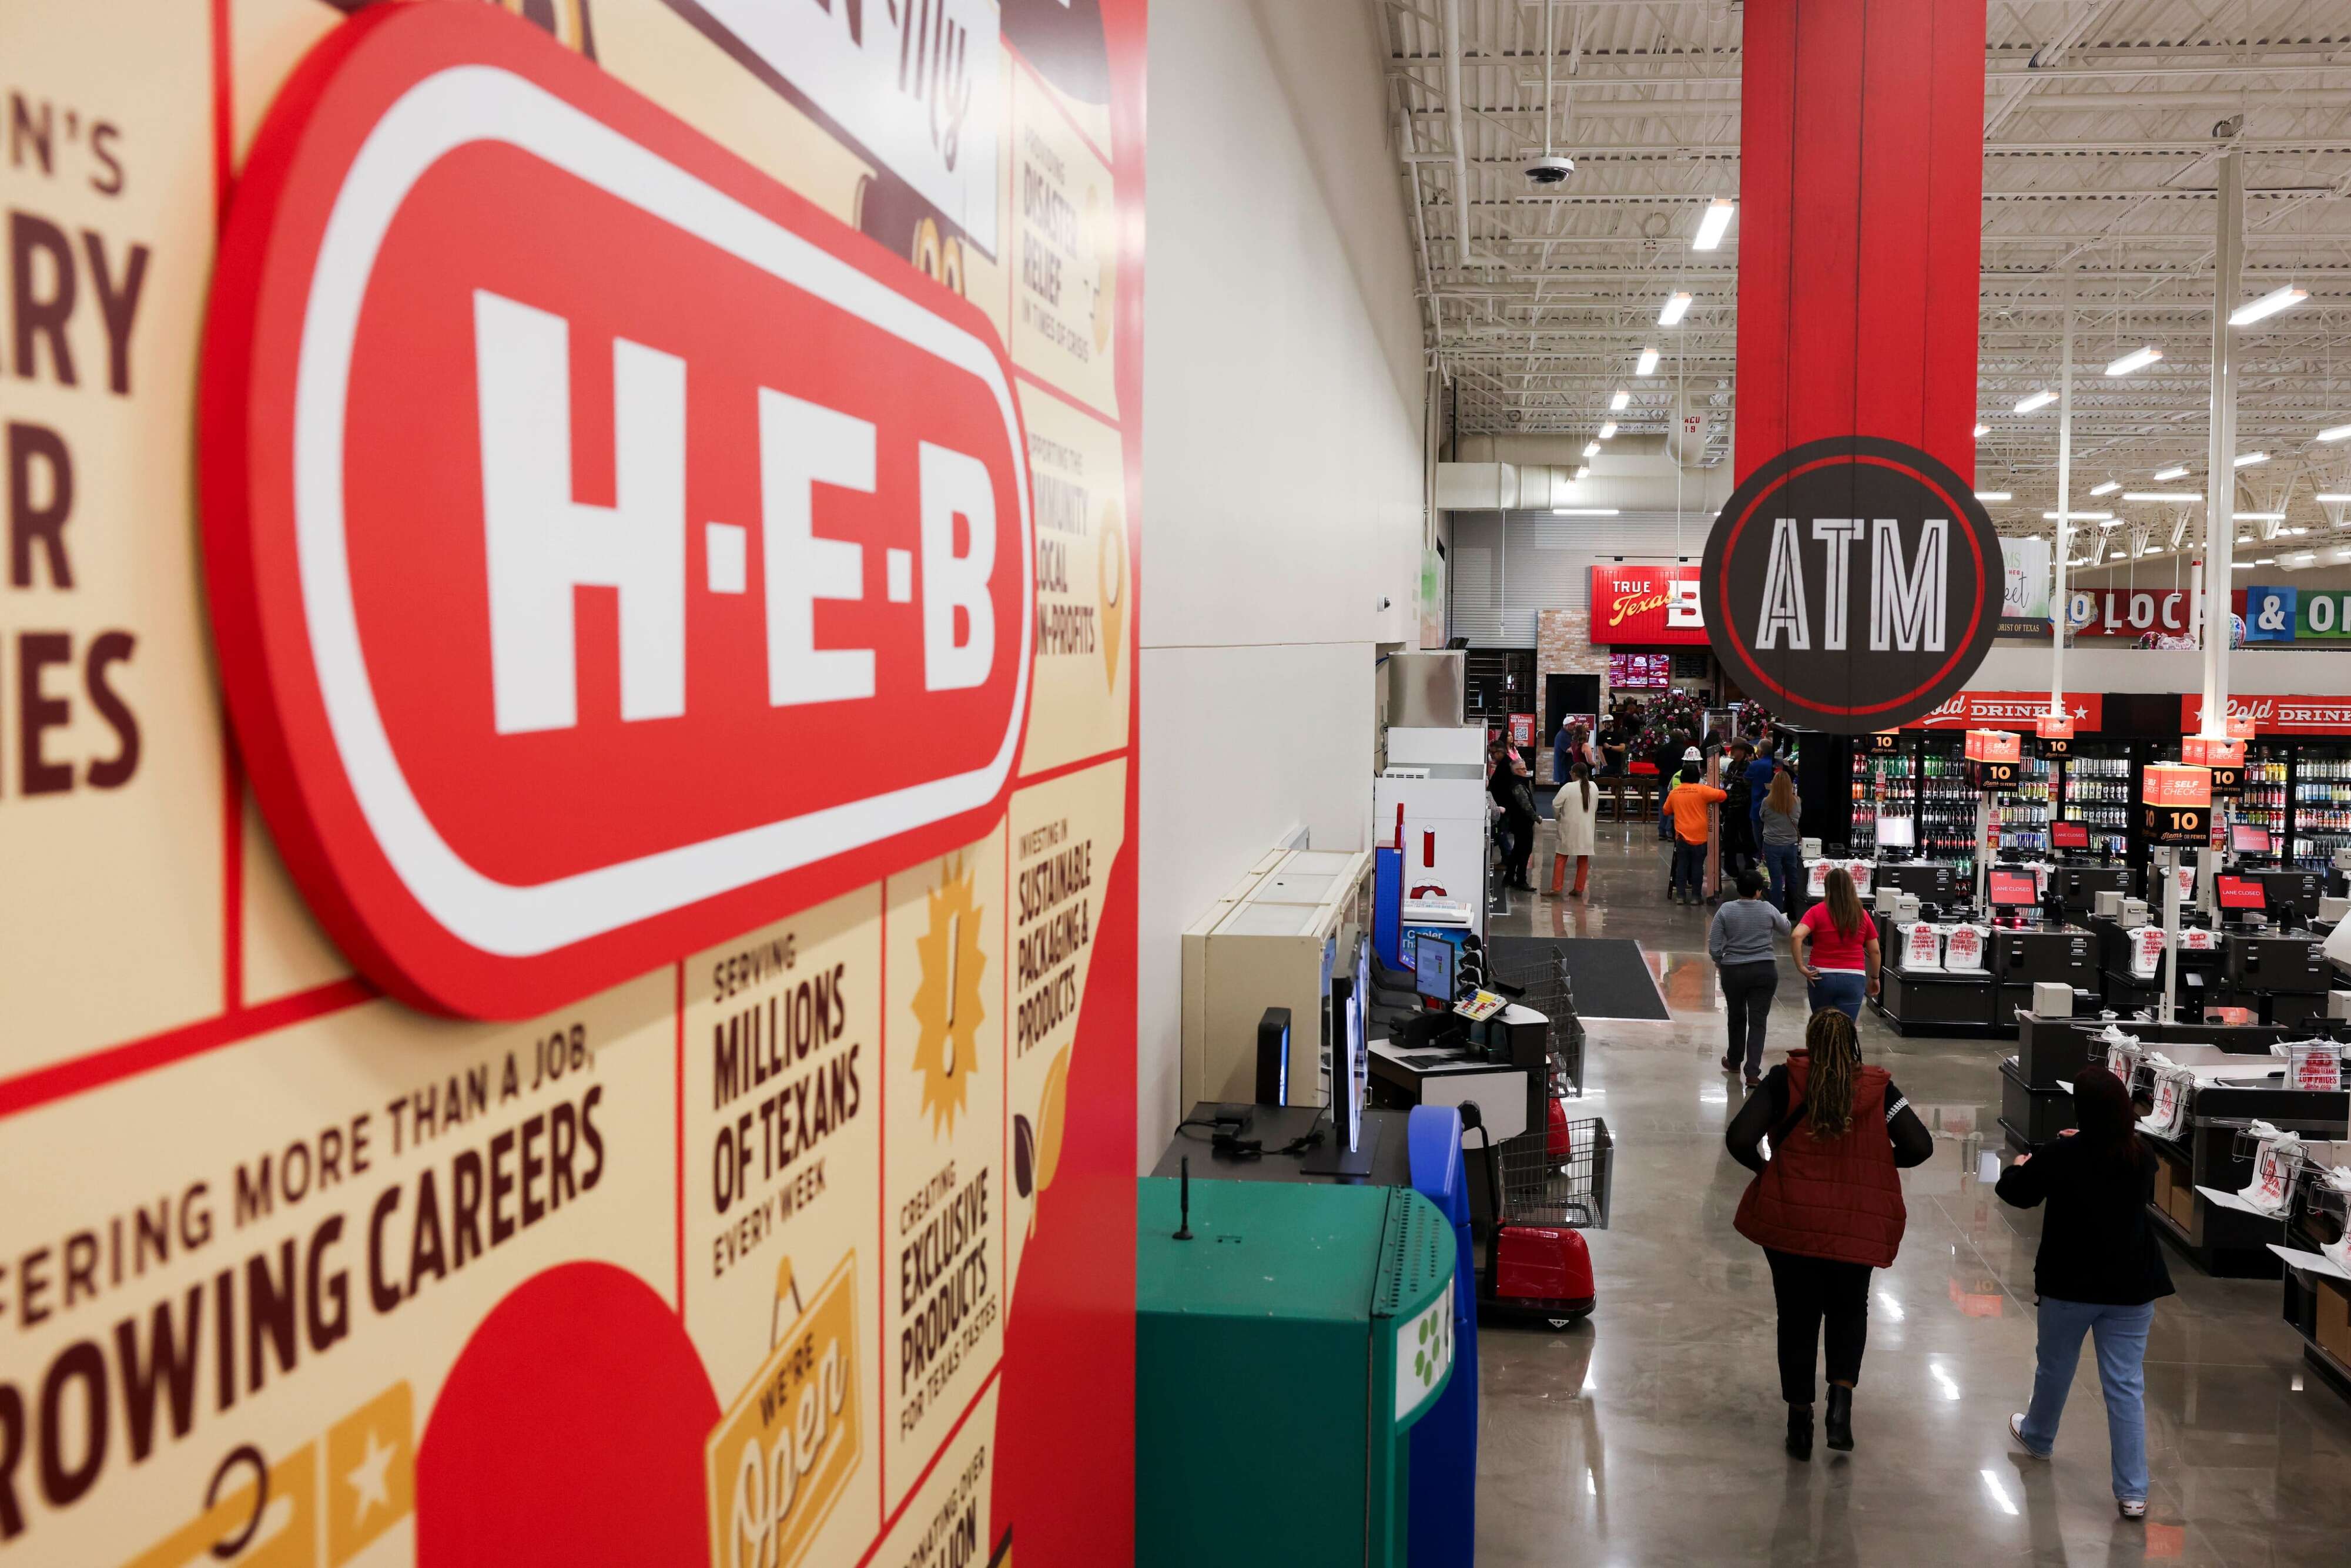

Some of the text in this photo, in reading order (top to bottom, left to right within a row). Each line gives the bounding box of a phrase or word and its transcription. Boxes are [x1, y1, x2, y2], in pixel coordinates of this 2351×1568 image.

[1, 209, 152, 398] RY
[1609, 591, 1673, 627] Texas
[1612, 581, 1651, 593] TRUE
[1754, 518, 1949, 652] ATM
[2258, 595, 2286, 630] &
[2022, 624, 2040, 632] TEXAS
[1, 629, 142, 799] ES
[1876, 736, 1893, 747] 10
[1925, 695, 2067, 717] old DRINK
[2051, 741, 2067, 752] 10
[1990, 766, 2011, 780] 10
[2174, 780, 2199, 788] SELF
[2213, 771, 2235, 785] 10
[2161, 832, 2183, 841] Items
[2170, 812, 2199, 830] 10
[1018, 837, 1091, 927] SUSTAINABLE
[712, 932, 797, 1005] SERVING
[1018, 902, 1079, 993] PACKAGING
[714, 961, 846, 1112] MILLIONS
[1017, 962, 1076, 1059] PRODUCTS
[2315, 1074, 2337, 1084] PRICES
[233, 1113, 372, 1229] MORE
[386, 1059, 490, 1157] THAN
[498, 1052, 521, 1105] A
[713, 1043, 860, 1215] OF TEXANS
[366, 1084, 605, 1315] CAREERS
[713, 1155, 826, 1279] EVERY WEEK
[900, 1160, 956, 1236] CREATING
[902, 1166, 989, 1318] EXCLUSIVE
[901, 1236, 987, 1398] PRODUCTS
[900, 1292, 997, 1443] FOR TEXAS TASTES
[903, 1445, 986, 1568] ONATING OVER
